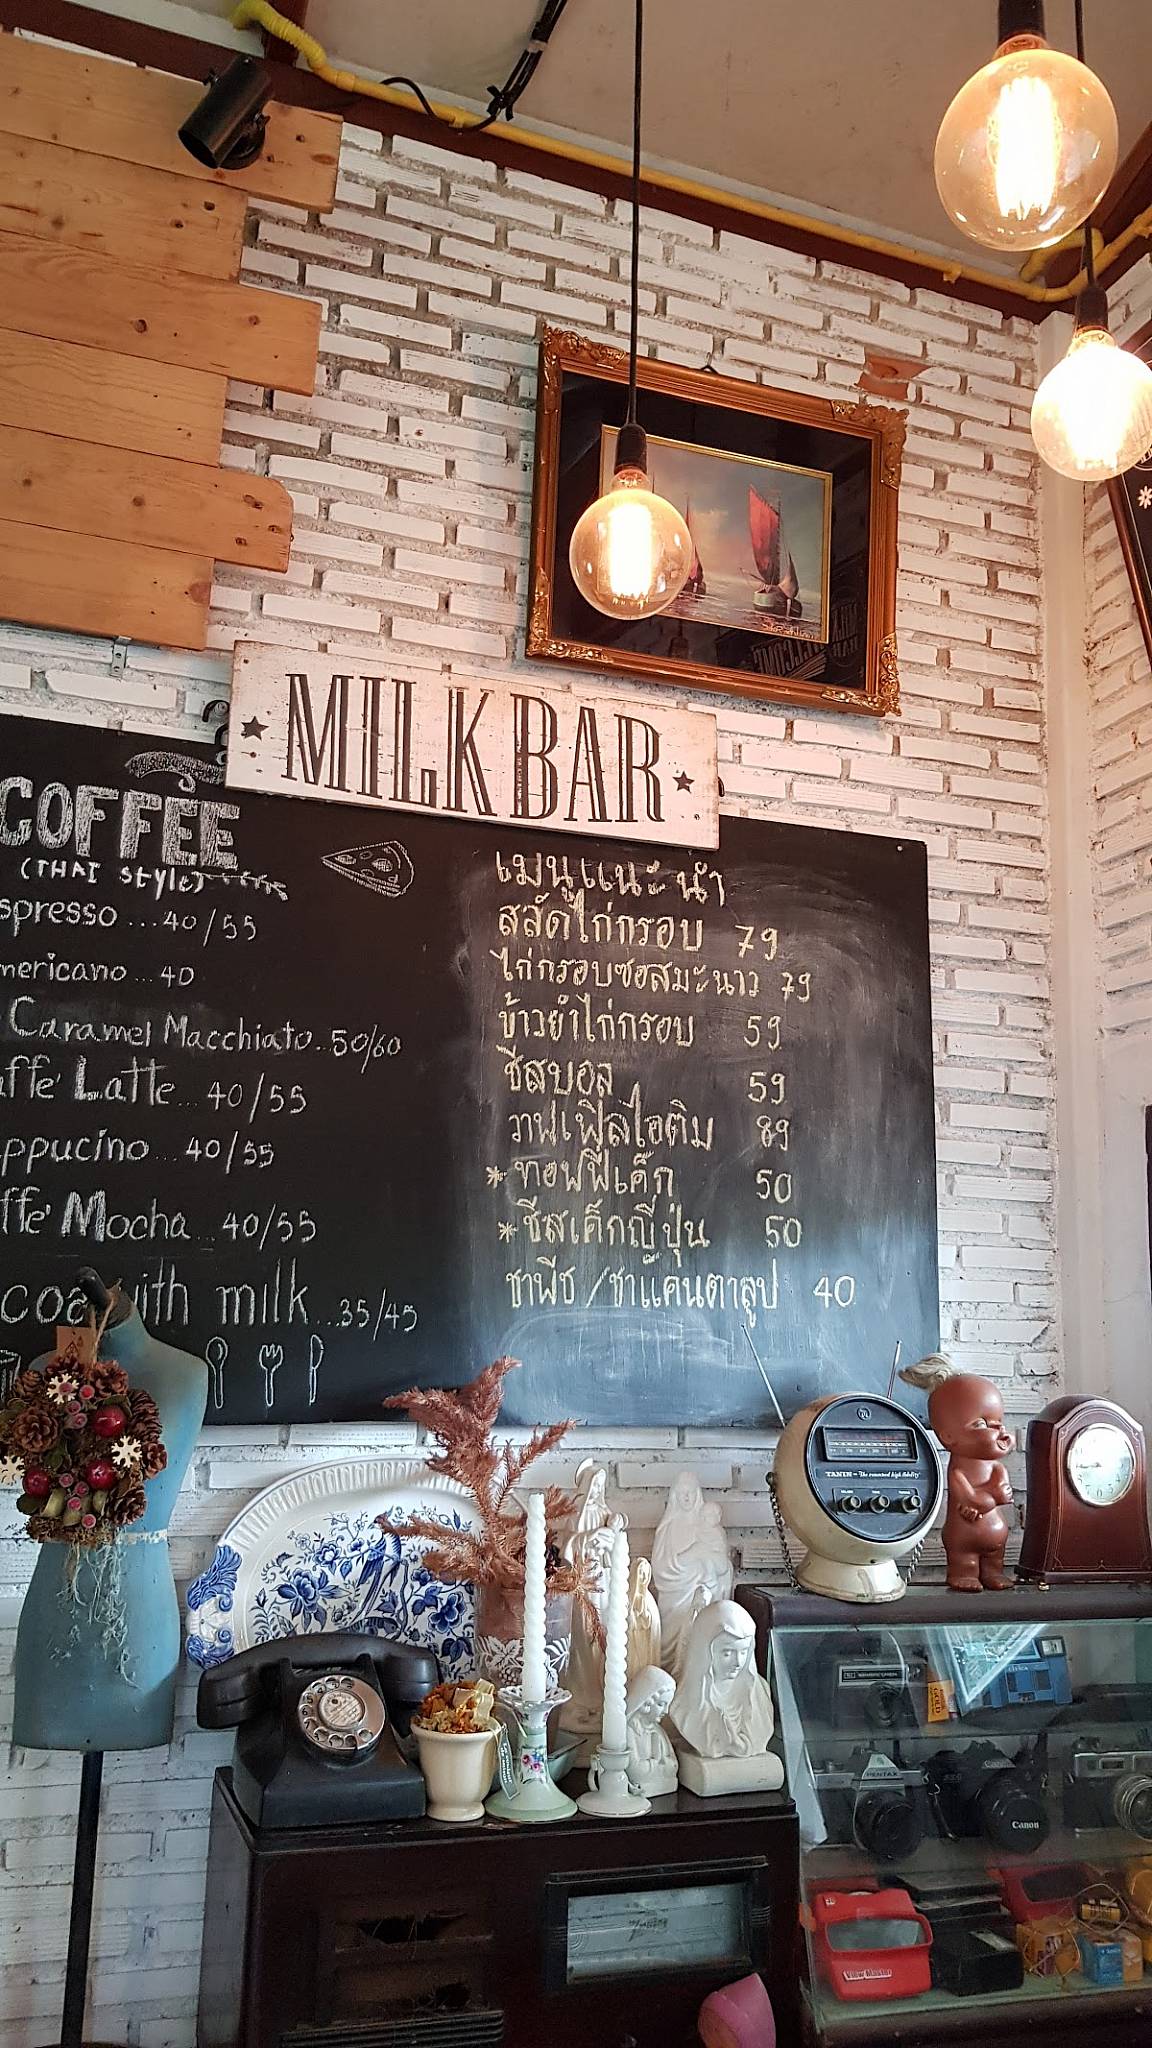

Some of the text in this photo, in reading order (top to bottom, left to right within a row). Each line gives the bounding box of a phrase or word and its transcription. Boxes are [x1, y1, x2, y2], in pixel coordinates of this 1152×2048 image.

[0, 776, 241, 870] COFFEE
[735, 924, 779, 961] 79
[160, 965, 195, 988] 40
[781, 971, 811, 1003] 79
[9, 996, 152, 1047] Caramel
[331, 1024, 401, 1074] 50/60
[743, 1015, 782, 1050] 59
[74, 1054, 176, 1106] Latte
[207, 1073, 307, 1123] 40/55
[748, 1071, 785, 1105] 59
[756, 1115, 790, 1150] 89
[185, 1131, 274, 1174] 40/55
[756, 1169, 792, 1204] 50
[61, 1190, 191, 1243] Mocha
[222, 1203, 317, 1252] 40/55
[765, 1215, 801, 1249] 50
[134, 1257, 189, 1325] ith
[216, 1258, 309, 1326] milk
[339, 1288, 419, 1341] 35/45
[813, 1275, 855, 1308] 40
[1012, 1820, 1040, 1830] Canon
